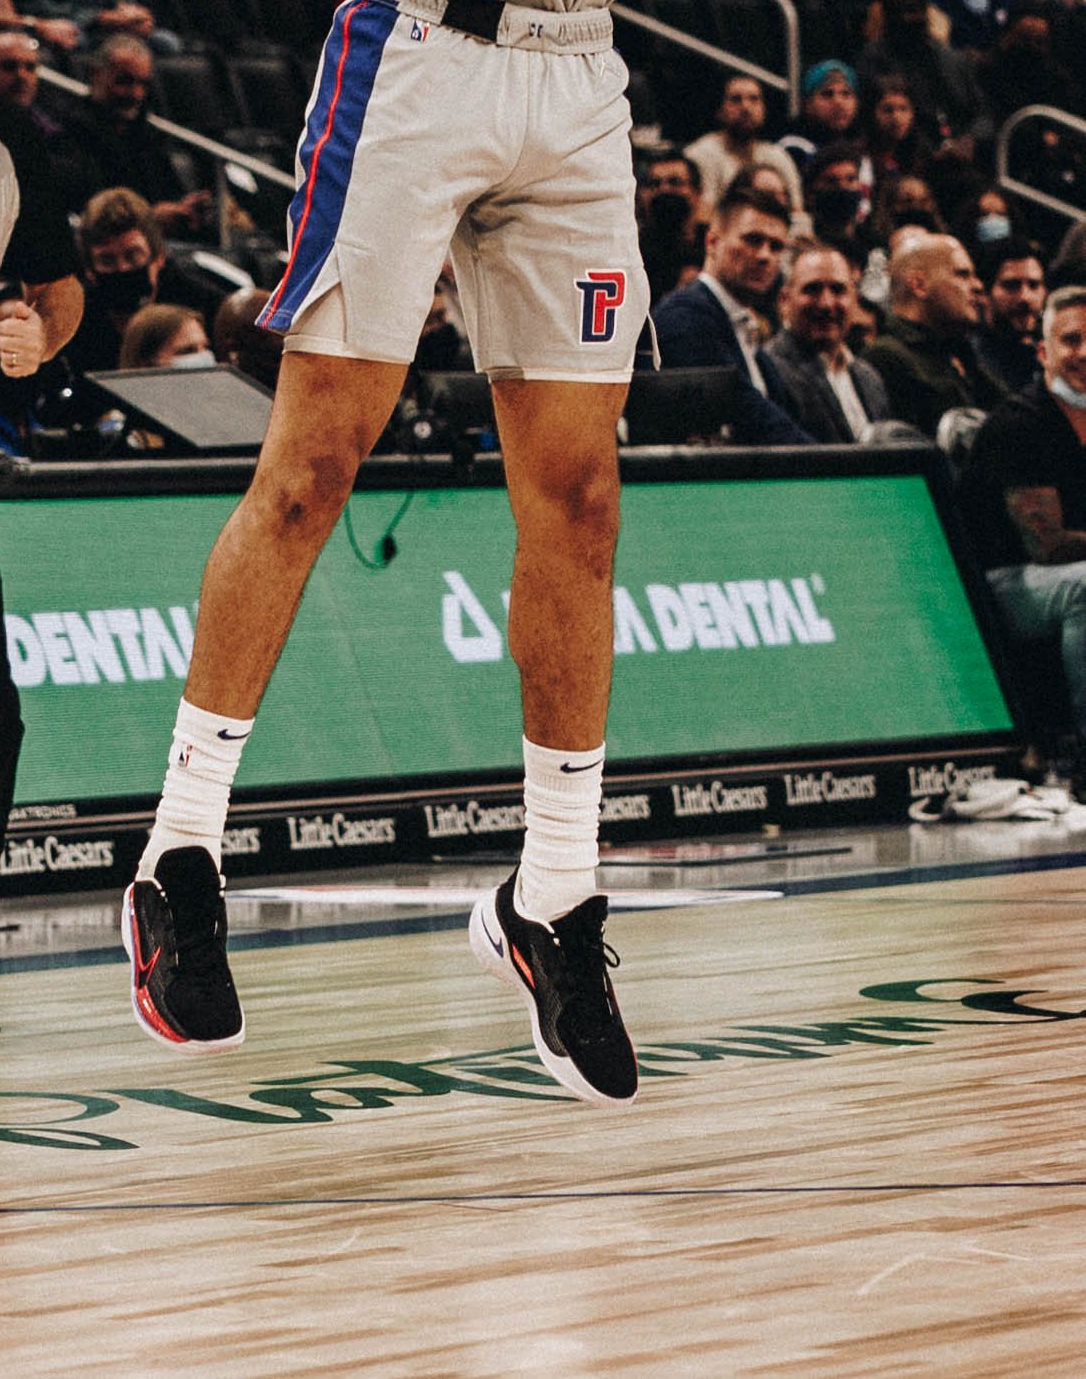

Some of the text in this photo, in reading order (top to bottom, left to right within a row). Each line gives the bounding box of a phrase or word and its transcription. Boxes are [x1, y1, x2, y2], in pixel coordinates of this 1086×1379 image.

[646, 578, 836, 652] DENTAL
[4, 606, 195, 688] DENTAL
[783, 772, 876, 806] Little Caesars
[907, 762, 996, 797] Little Caesar
[598, 794, 651, 822] aesars
[671, 781, 768, 817] Little Caesars
[287, 813, 396, 850] Little Caesars
[424, 800, 526, 838] Little Caesar
[44, 835, 114, 871] Caesars
[220, 827, 262, 855] sars
